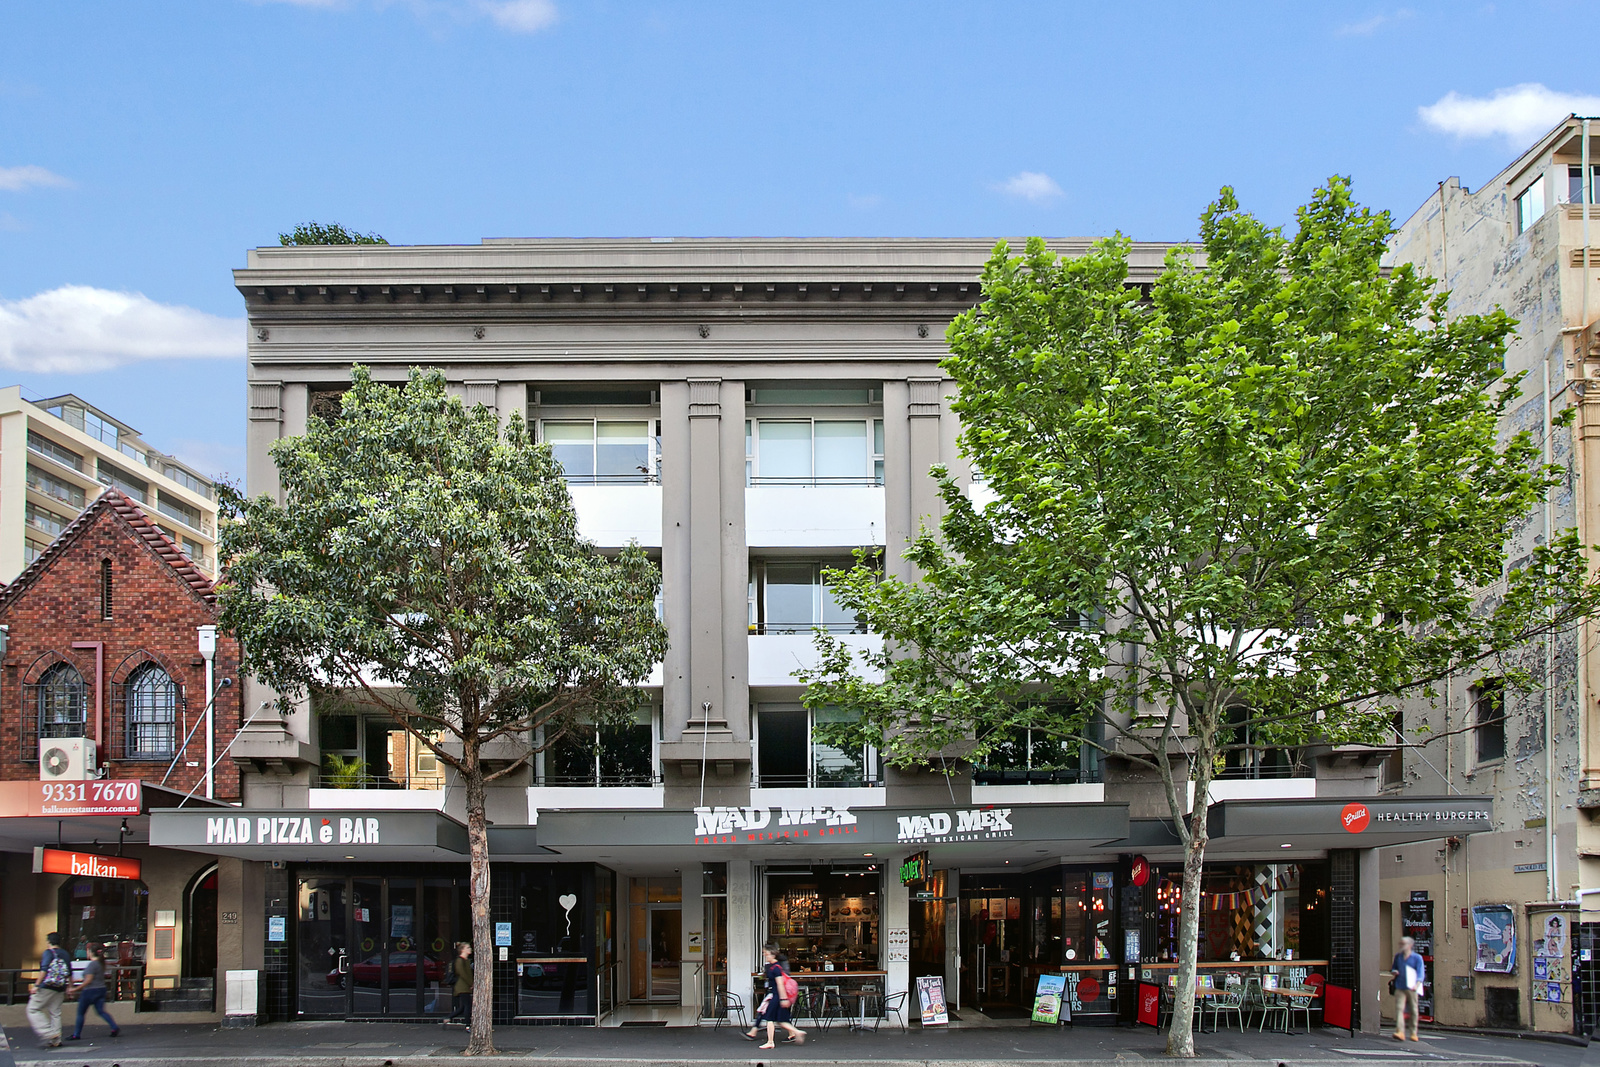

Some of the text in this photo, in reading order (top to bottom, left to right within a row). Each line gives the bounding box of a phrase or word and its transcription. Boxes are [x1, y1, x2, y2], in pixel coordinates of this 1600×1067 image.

[42, 782, 138, 802] 9331 7670
[42, 805, 138, 814] balkanrestaurant.com.au
[1344, 808, 1366, 826] Grill'd
[1377, 811, 1489, 822] HEALTHY BURGERS
[694, 804, 857, 836] MAD MEX
[897, 808, 1013, 840] MAD MEX
[206, 817, 251, 844] MAD
[257, 817, 314, 844] PIZZA
[339, 817, 380, 844] BAR
[695, 826, 858, 845] FRESH MEXICAN GRILL
[935, 834, 979, 843] MEXICAN
[985, 831, 1014, 839] GRILL
[71, 854, 117, 878] balkan
[222, 912, 237, 920] 249
[1289, 967, 1308, 978] HEAL
